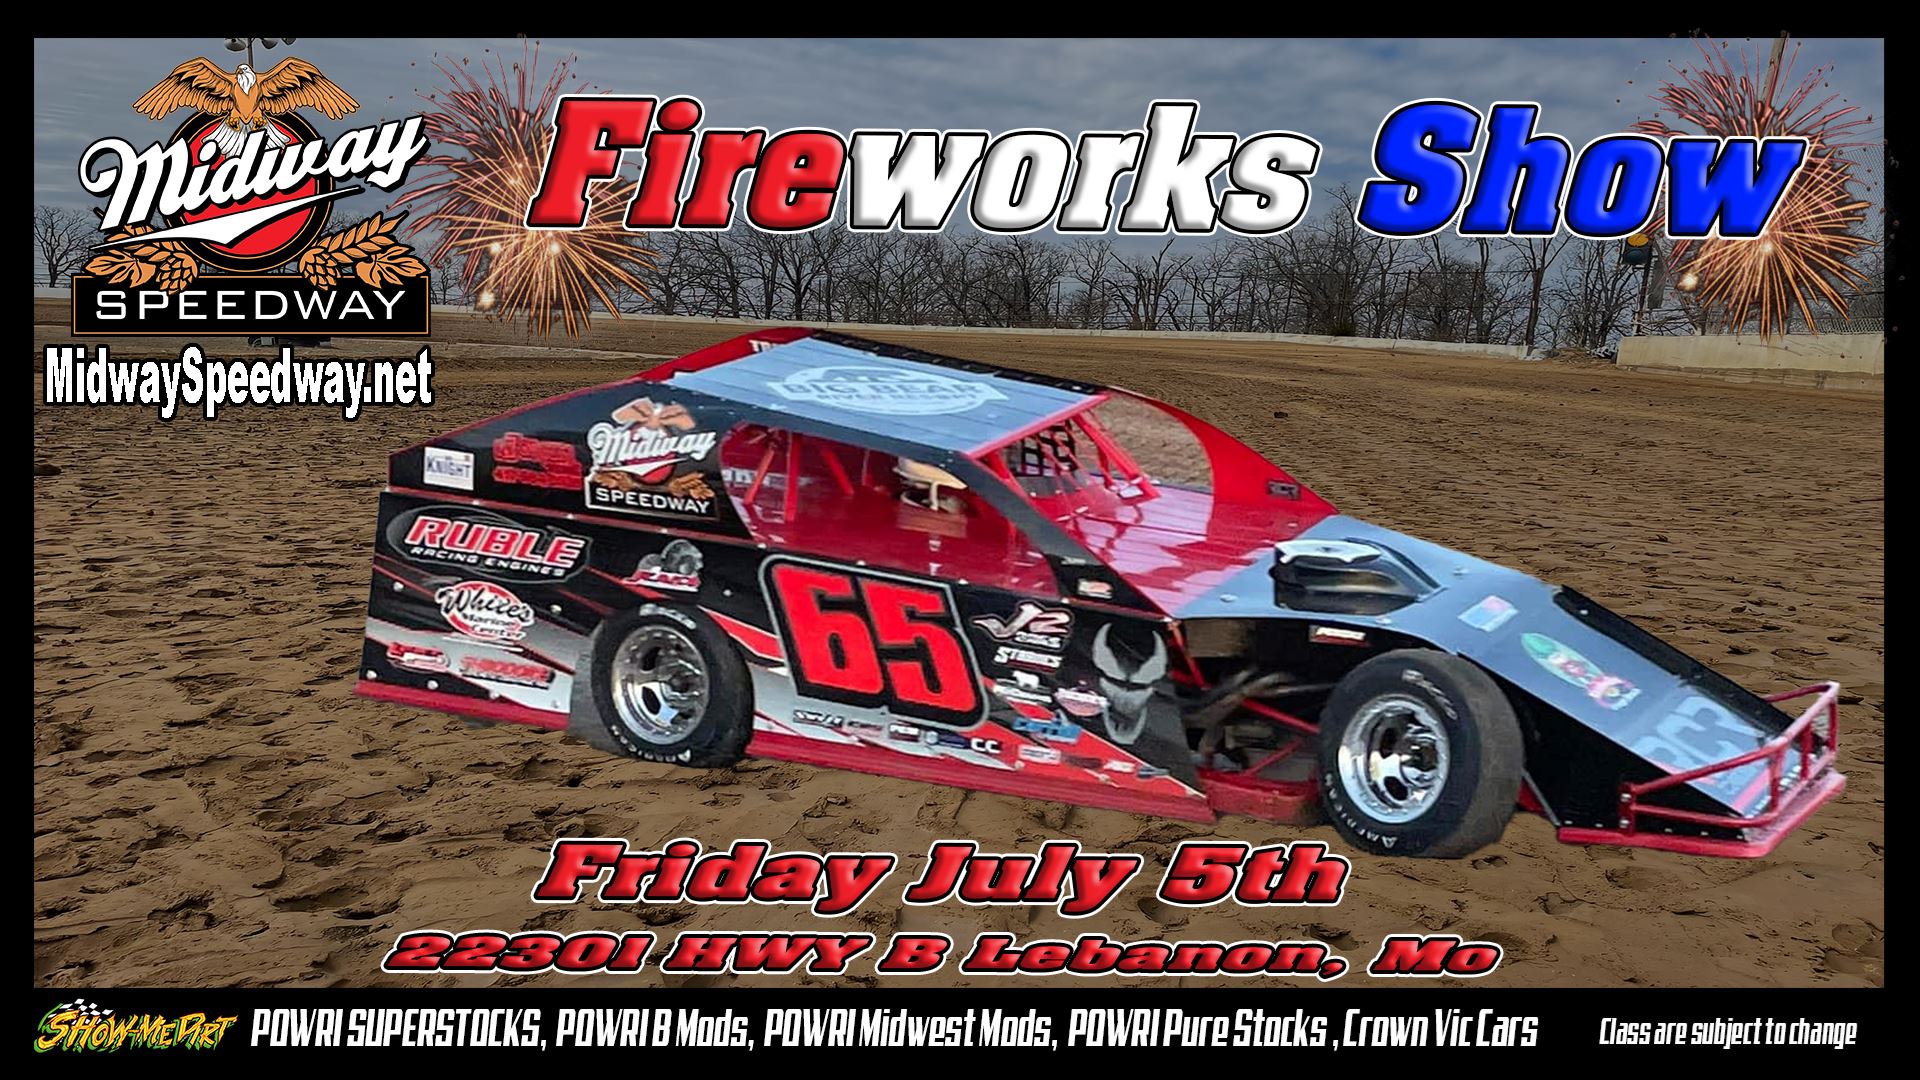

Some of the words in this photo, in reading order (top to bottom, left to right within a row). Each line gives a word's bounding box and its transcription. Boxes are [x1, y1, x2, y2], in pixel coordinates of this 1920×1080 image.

[586, 422, 717, 466] Midway
[594, 486, 711, 513] SPEEDWAY
[404, 515, 586, 568] RUBLE
[410, 546, 478, 564] RACING
[484, 557, 567, 577] ENGINES
[437, 587, 532, 621] White's
[773, 566, 980, 713] 65
